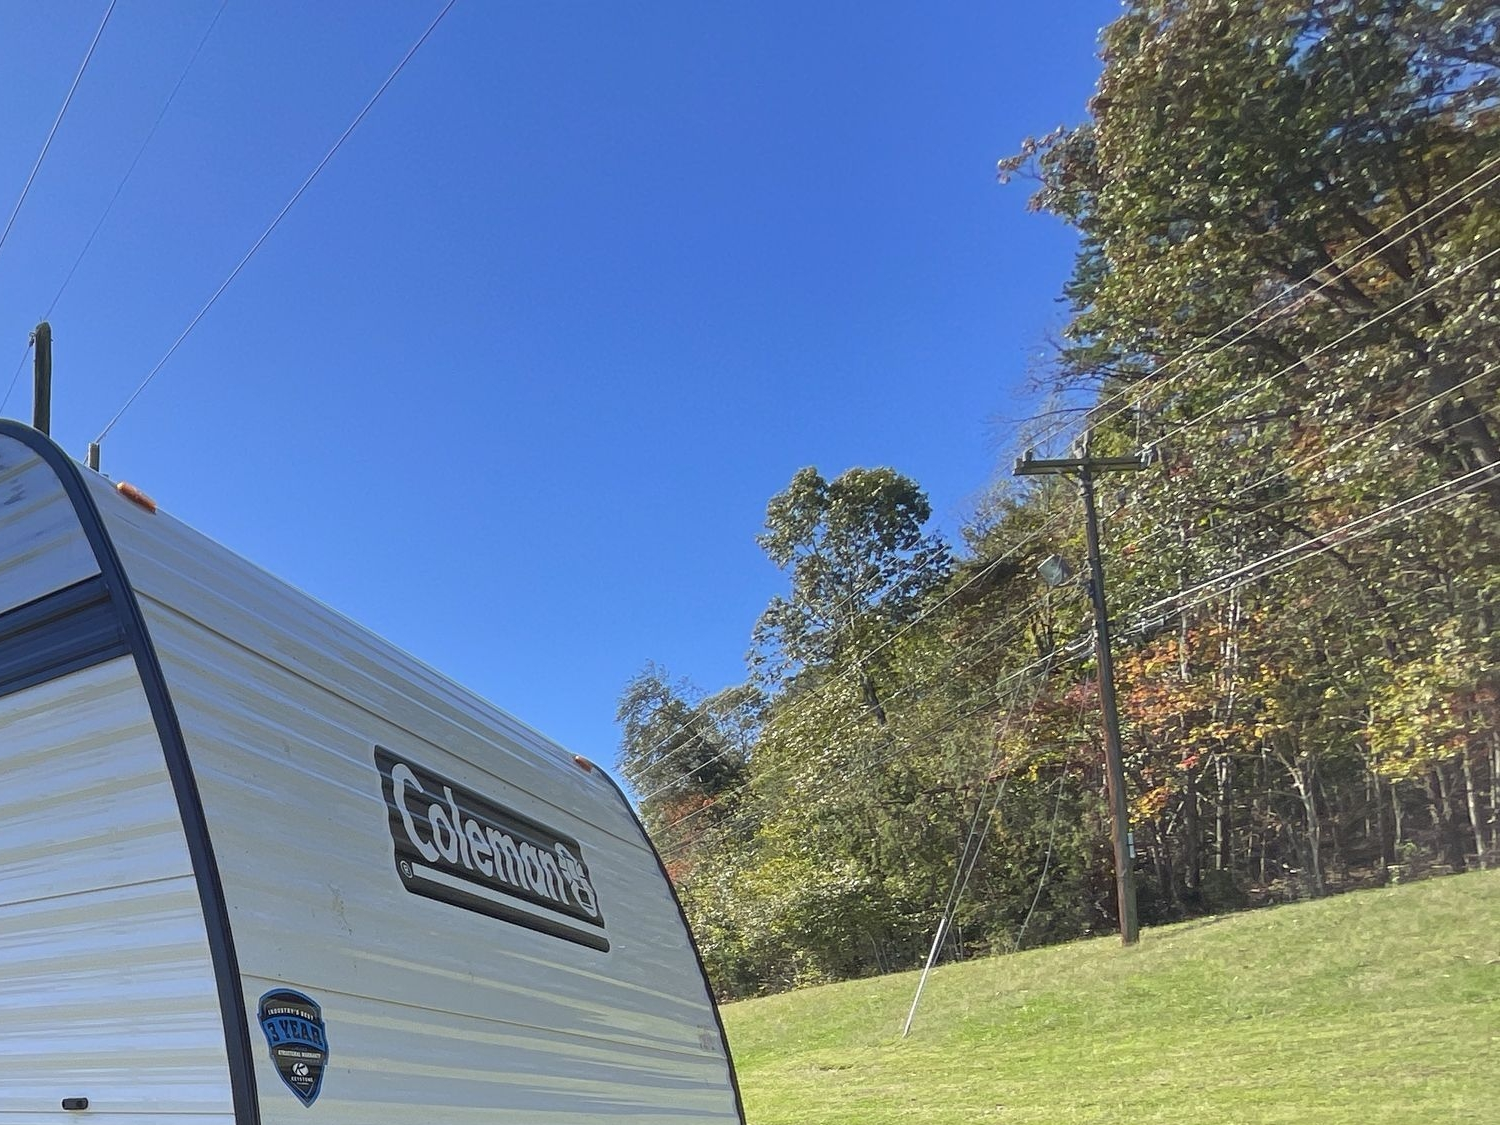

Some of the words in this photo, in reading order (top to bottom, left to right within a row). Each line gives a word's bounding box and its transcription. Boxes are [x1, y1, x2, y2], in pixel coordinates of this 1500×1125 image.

[391, 763, 570, 906] Coleman
[267, 1022, 280, 1042] 3
[279, 1019, 324, 1046] YEAR
